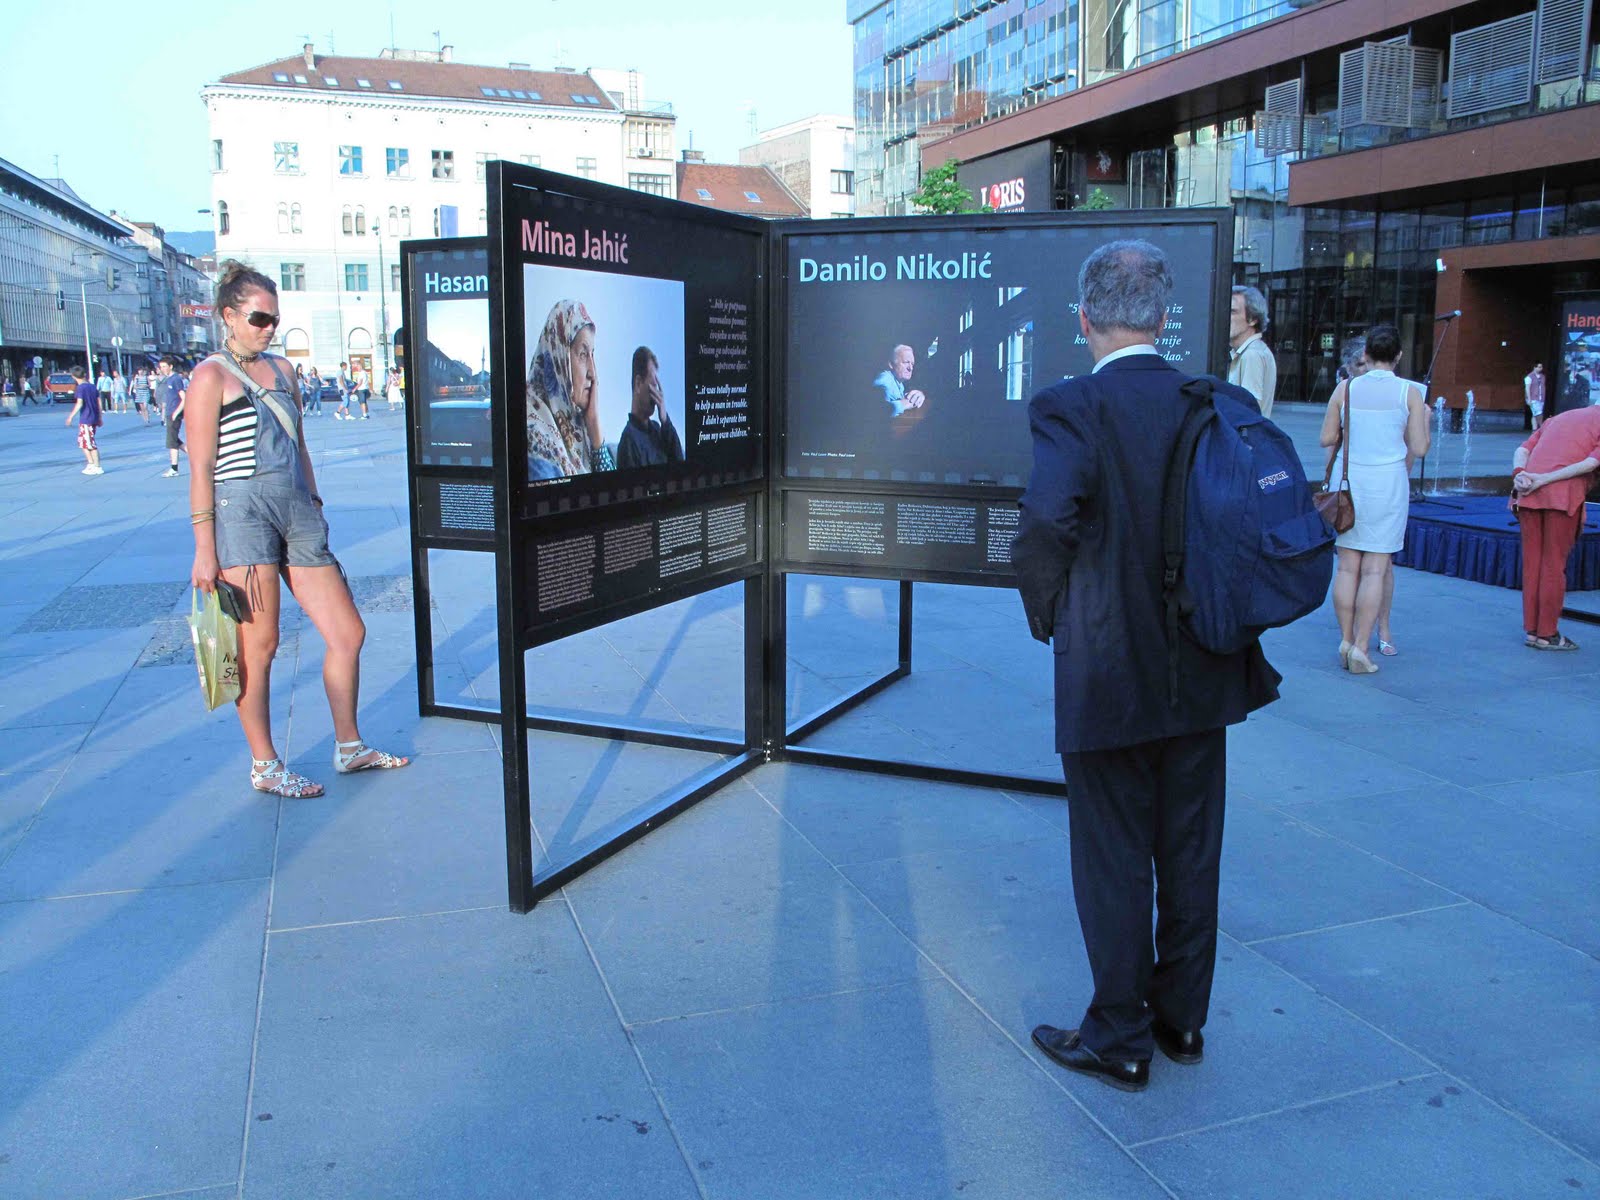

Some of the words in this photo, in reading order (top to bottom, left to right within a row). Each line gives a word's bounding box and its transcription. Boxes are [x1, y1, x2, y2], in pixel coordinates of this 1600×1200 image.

[521, 219, 576, 258] Mina
[582, 229, 629, 264] Jahić
[800, 254, 887, 282] Danilo
[896, 251, 992, 281] Nikolić
[425, 272, 489, 293] Hasan
[1172, 303, 1183, 314] iz
[1161, 335, 1182, 348] nije
[700, 400, 710, 413] help
